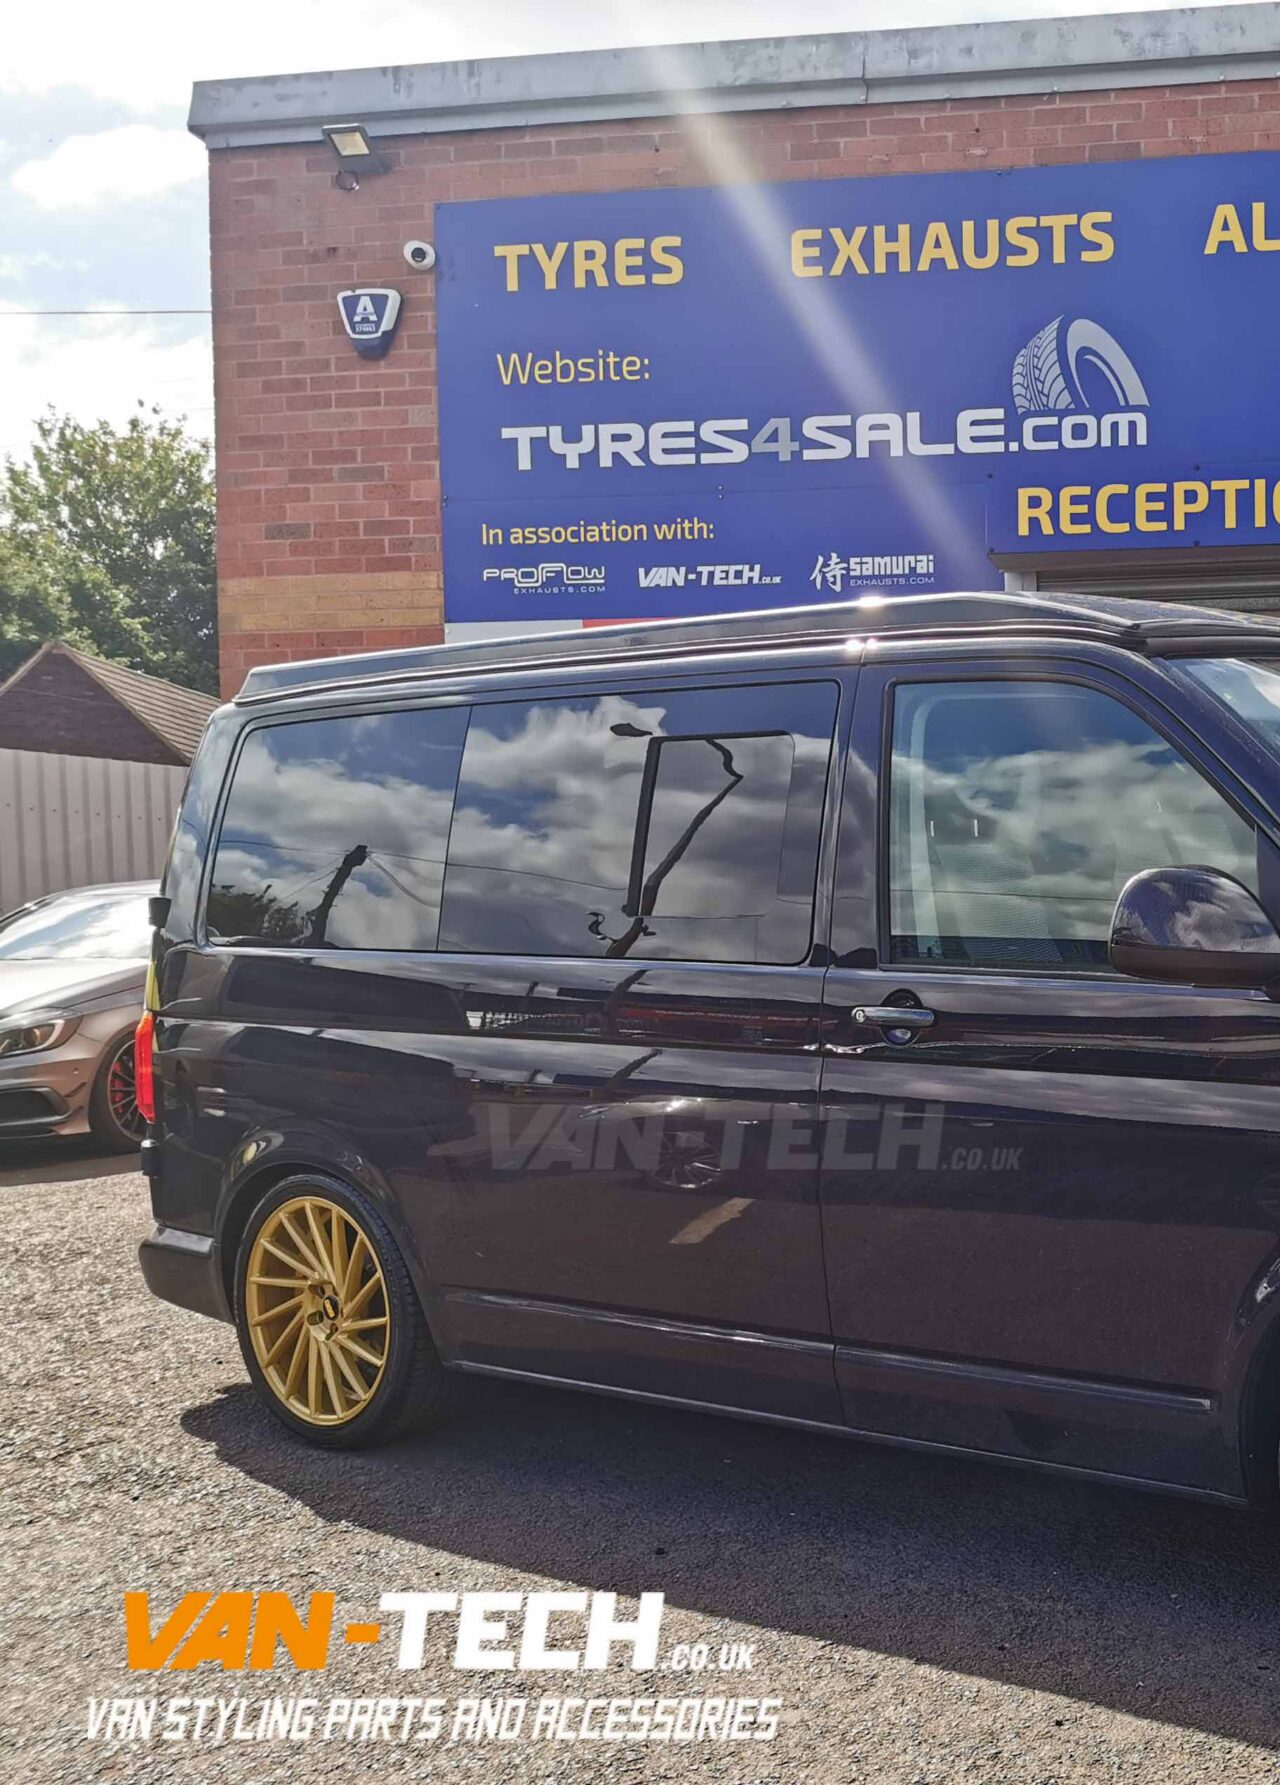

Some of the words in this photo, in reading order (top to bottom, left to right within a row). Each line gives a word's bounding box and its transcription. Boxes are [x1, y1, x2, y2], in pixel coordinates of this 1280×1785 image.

[494, 236, 684, 291] TYRES
[791, 211, 1114, 278] EXHAUSTS
[497, 348, 650, 386] Website:
[482, 523, 502, 545] In
[509, 519, 647, 544] association
[654, 517, 714, 540] with:
[514, 586, 606, 595] EXHAUSTS.COM
[809, 552, 850, 592] 侍
[850, 577, 935, 586] EXHAUSTS.COM
